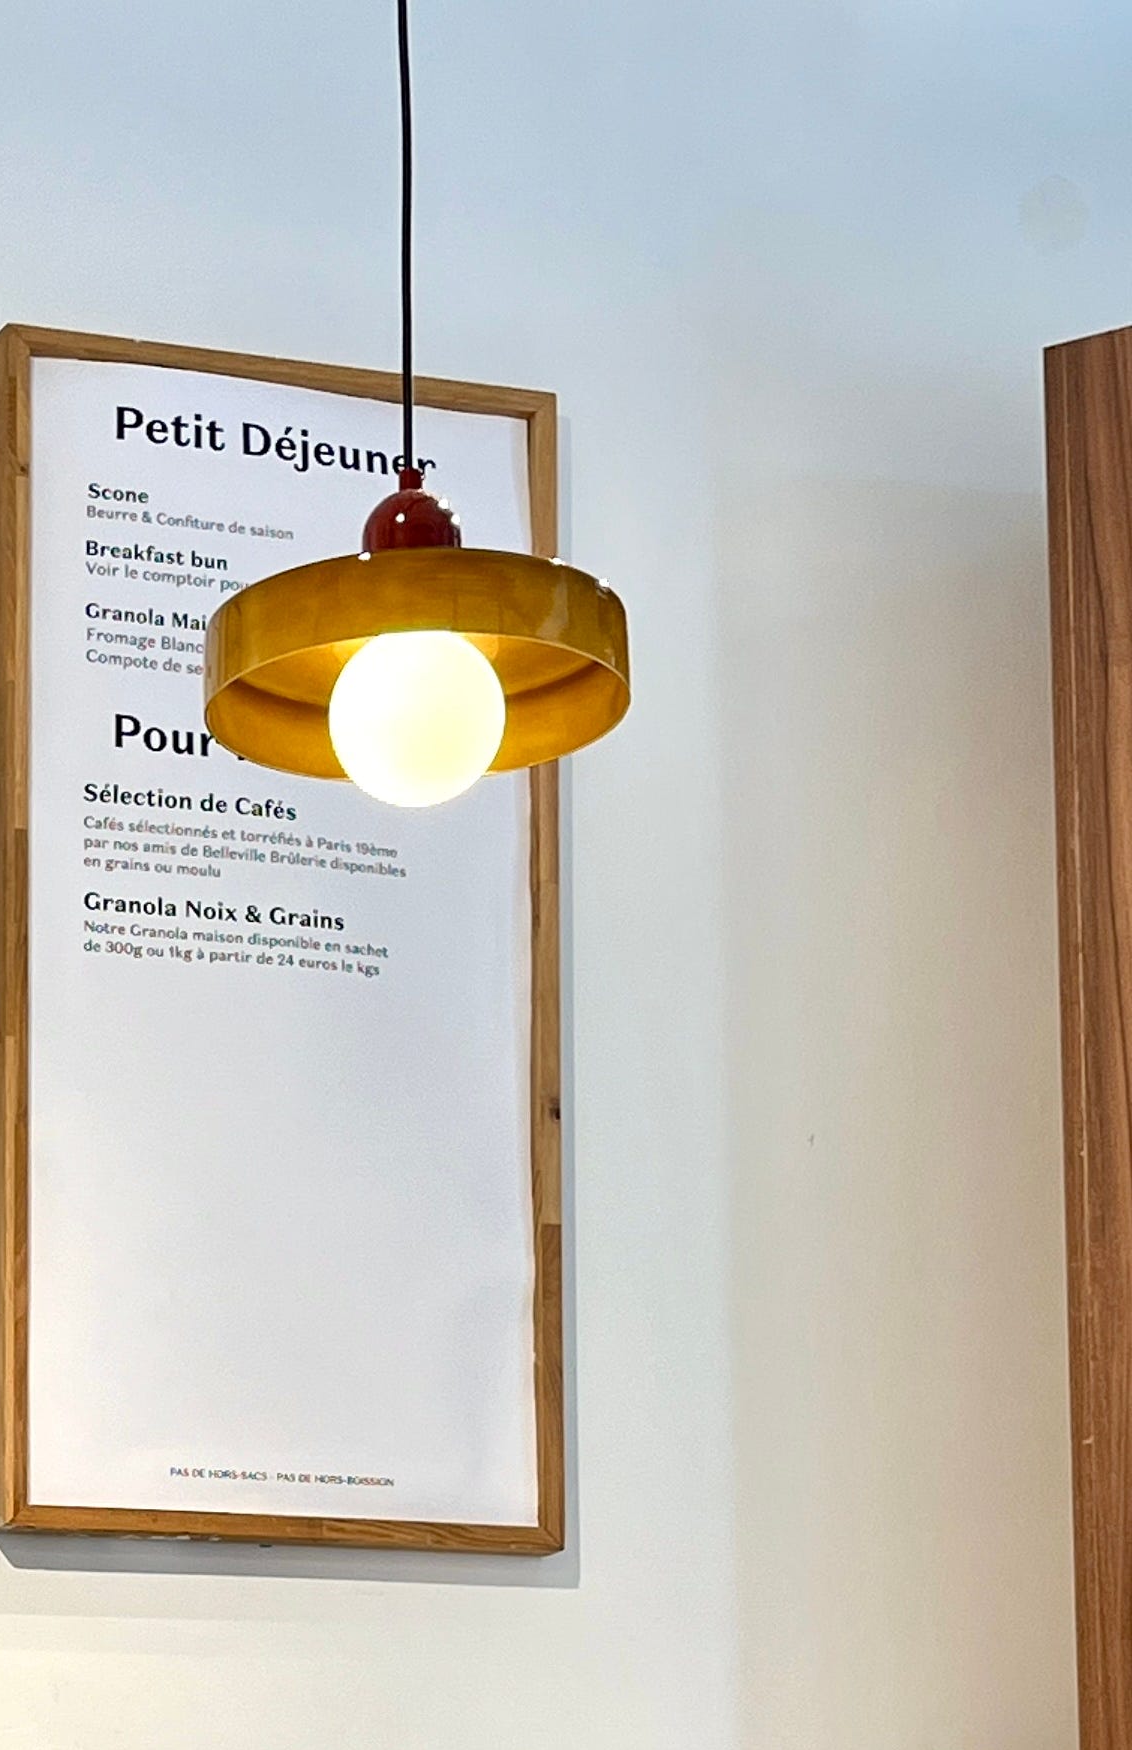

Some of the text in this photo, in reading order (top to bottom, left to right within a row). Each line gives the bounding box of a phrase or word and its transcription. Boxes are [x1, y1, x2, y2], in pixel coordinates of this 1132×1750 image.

[116, 406, 225, 452] Petit
[88, 482, 149, 503] Scone
[86, 505, 294, 540] Beurre & Confiture de saison
[86, 540, 228, 571] Breakfast bun
[86, 561, 119, 577] Voir
[124, 563, 138, 579] le
[143, 567, 215, 588] comptoir
[85, 602, 164, 626] Granola
[87, 628, 204, 654] Fromage Blanc
[86, 649, 158, 671] Compote
[163, 658, 181, 673] de
[114, 713, 215, 757] Pour
[83, 783, 297, 822] Sélection de Cafés
[83, 816, 124, 833] Cafés
[128, 819, 217, 840] sélectionnés
[221, 828, 236, 841] et
[240, 827, 302, 848] torréfiés
[305, 834, 314, 848] à
[317, 836, 352, 853] Paris
[83, 838, 406, 878] par nos amis de Belleville Brûlerie disponibles
[83, 856, 221, 878] en grains ou moulu
[83, 891, 345, 931] Granola Noix & Grains
[83, 919, 389, 958] Notre Granola maison disponible en sachet
[83, 938, 380, 978] de 300g ou 1kg à partir de 24 euros le kgs
